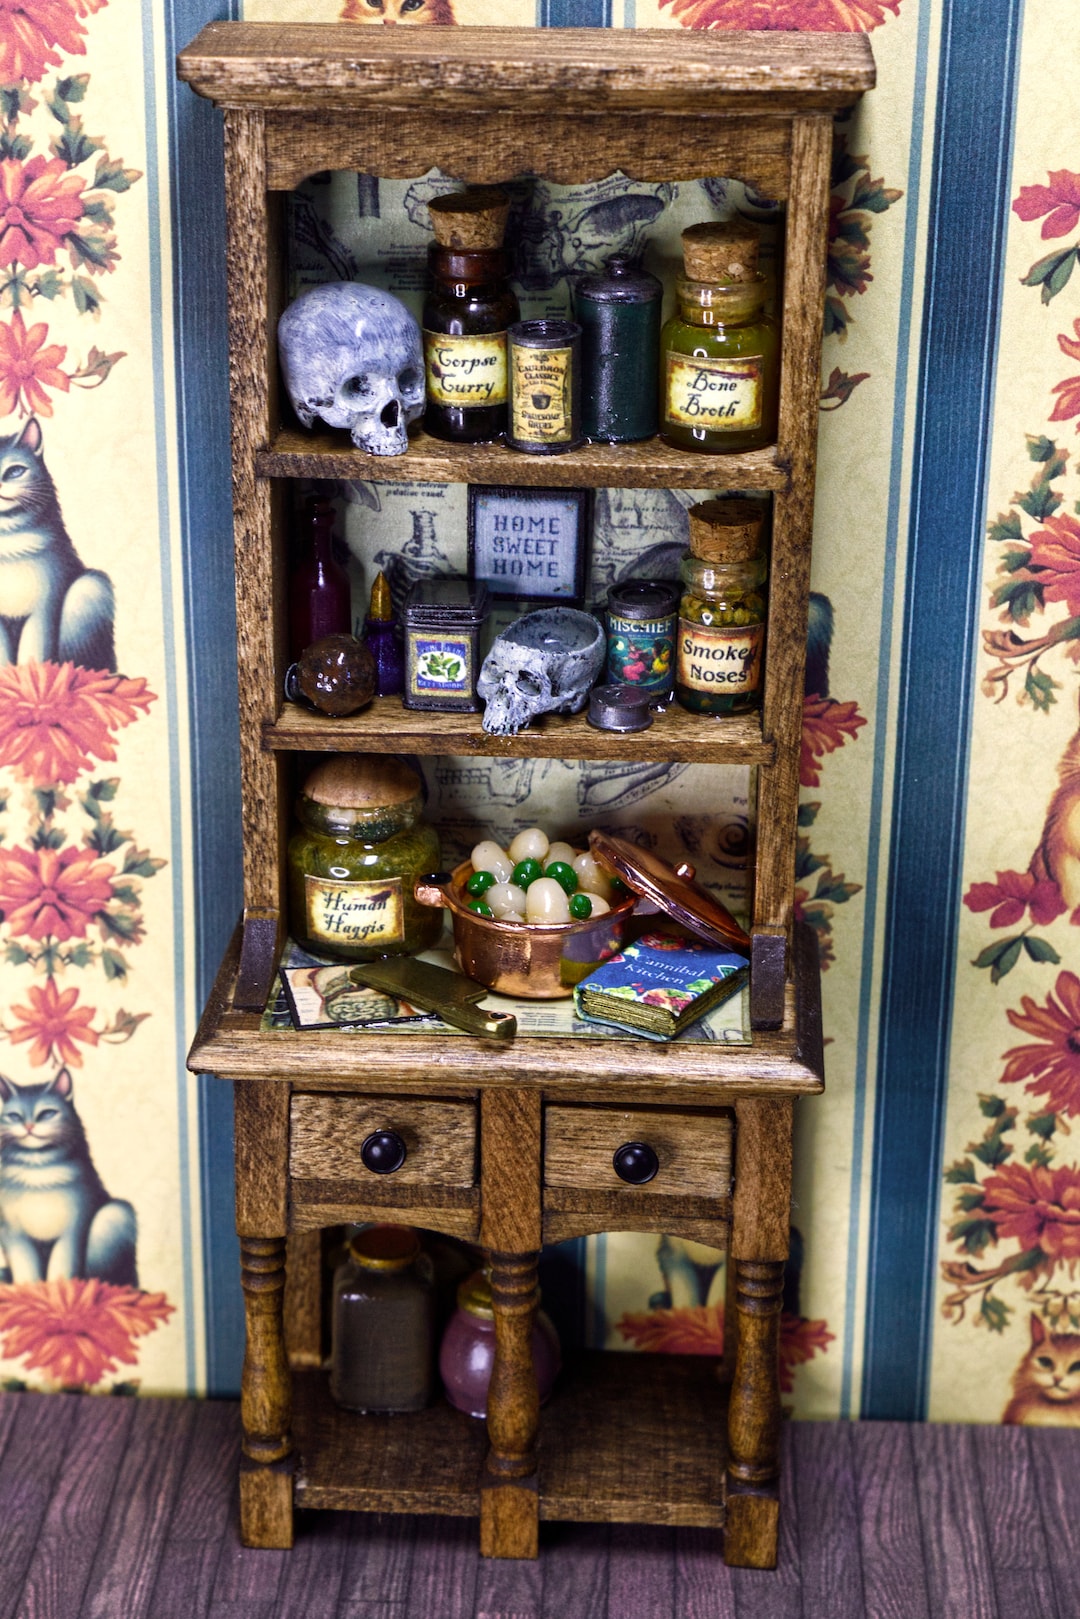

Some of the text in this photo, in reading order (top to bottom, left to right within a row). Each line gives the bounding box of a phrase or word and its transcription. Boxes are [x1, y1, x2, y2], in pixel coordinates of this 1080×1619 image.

[434, 347, 497, 375] Corpse
[517, 364, 566, 376] CAULDRON
[440, 372, 496, 400] Curry
[523, 372, 560, 381] CLASSICS
[686, 367, 737, 392] Bone
[679, 393, 742, 418] Broth
[493, 514, 560, 535] HOME
[492, 536, 560, 556] SWEET
[492, 558, 559, 578] HOME
[609, 616, 671, 634] MISCHIEF
[690, 664, 747, 683] Noses
[321, 889, 387, 911] Human
[323, 912, 386, 940] Haggis
[624, 963, 685, 985] Kitchen
[634, 954, 706, 978] Cannibal
